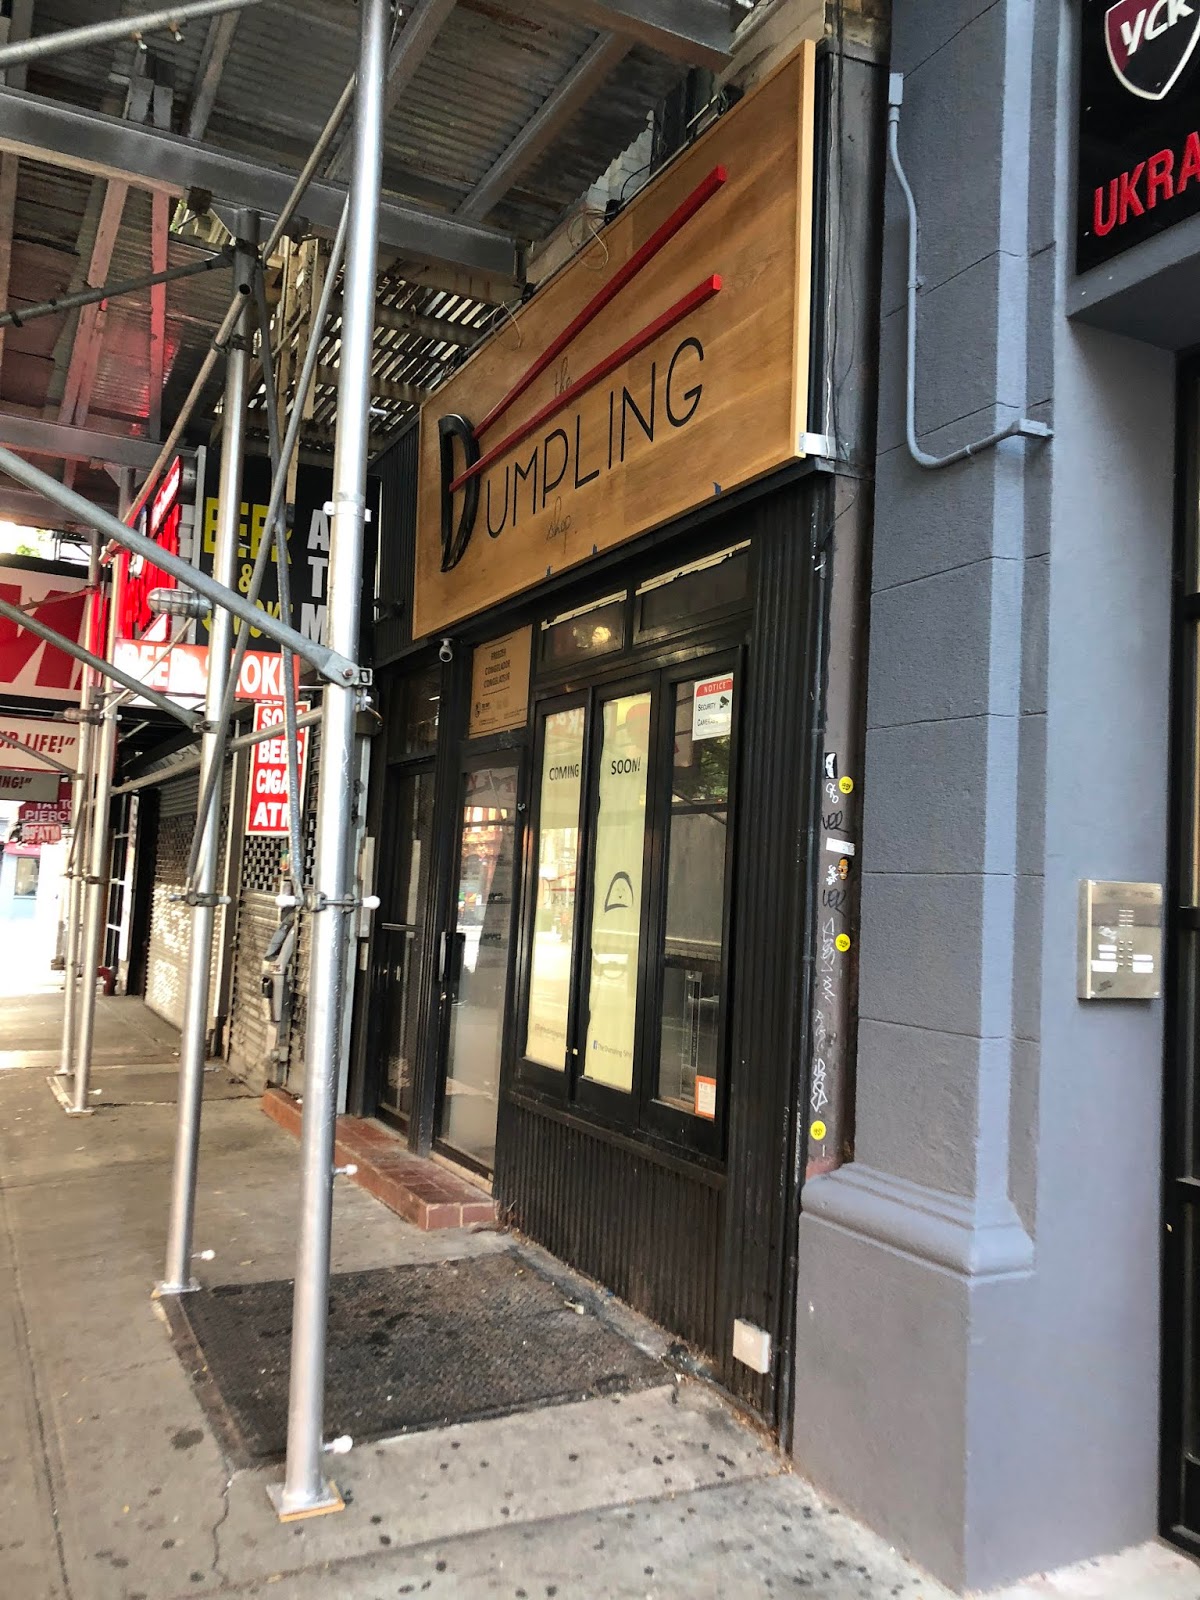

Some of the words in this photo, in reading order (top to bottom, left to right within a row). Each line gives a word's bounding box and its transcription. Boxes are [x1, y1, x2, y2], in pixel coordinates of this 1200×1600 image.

[438, 335, 705, 572] DUMPLING
[704, 681, 726, 693] NOTICE
[549, 762, 580, 782] COMING
[610, 756, 642, 776] SOON!
